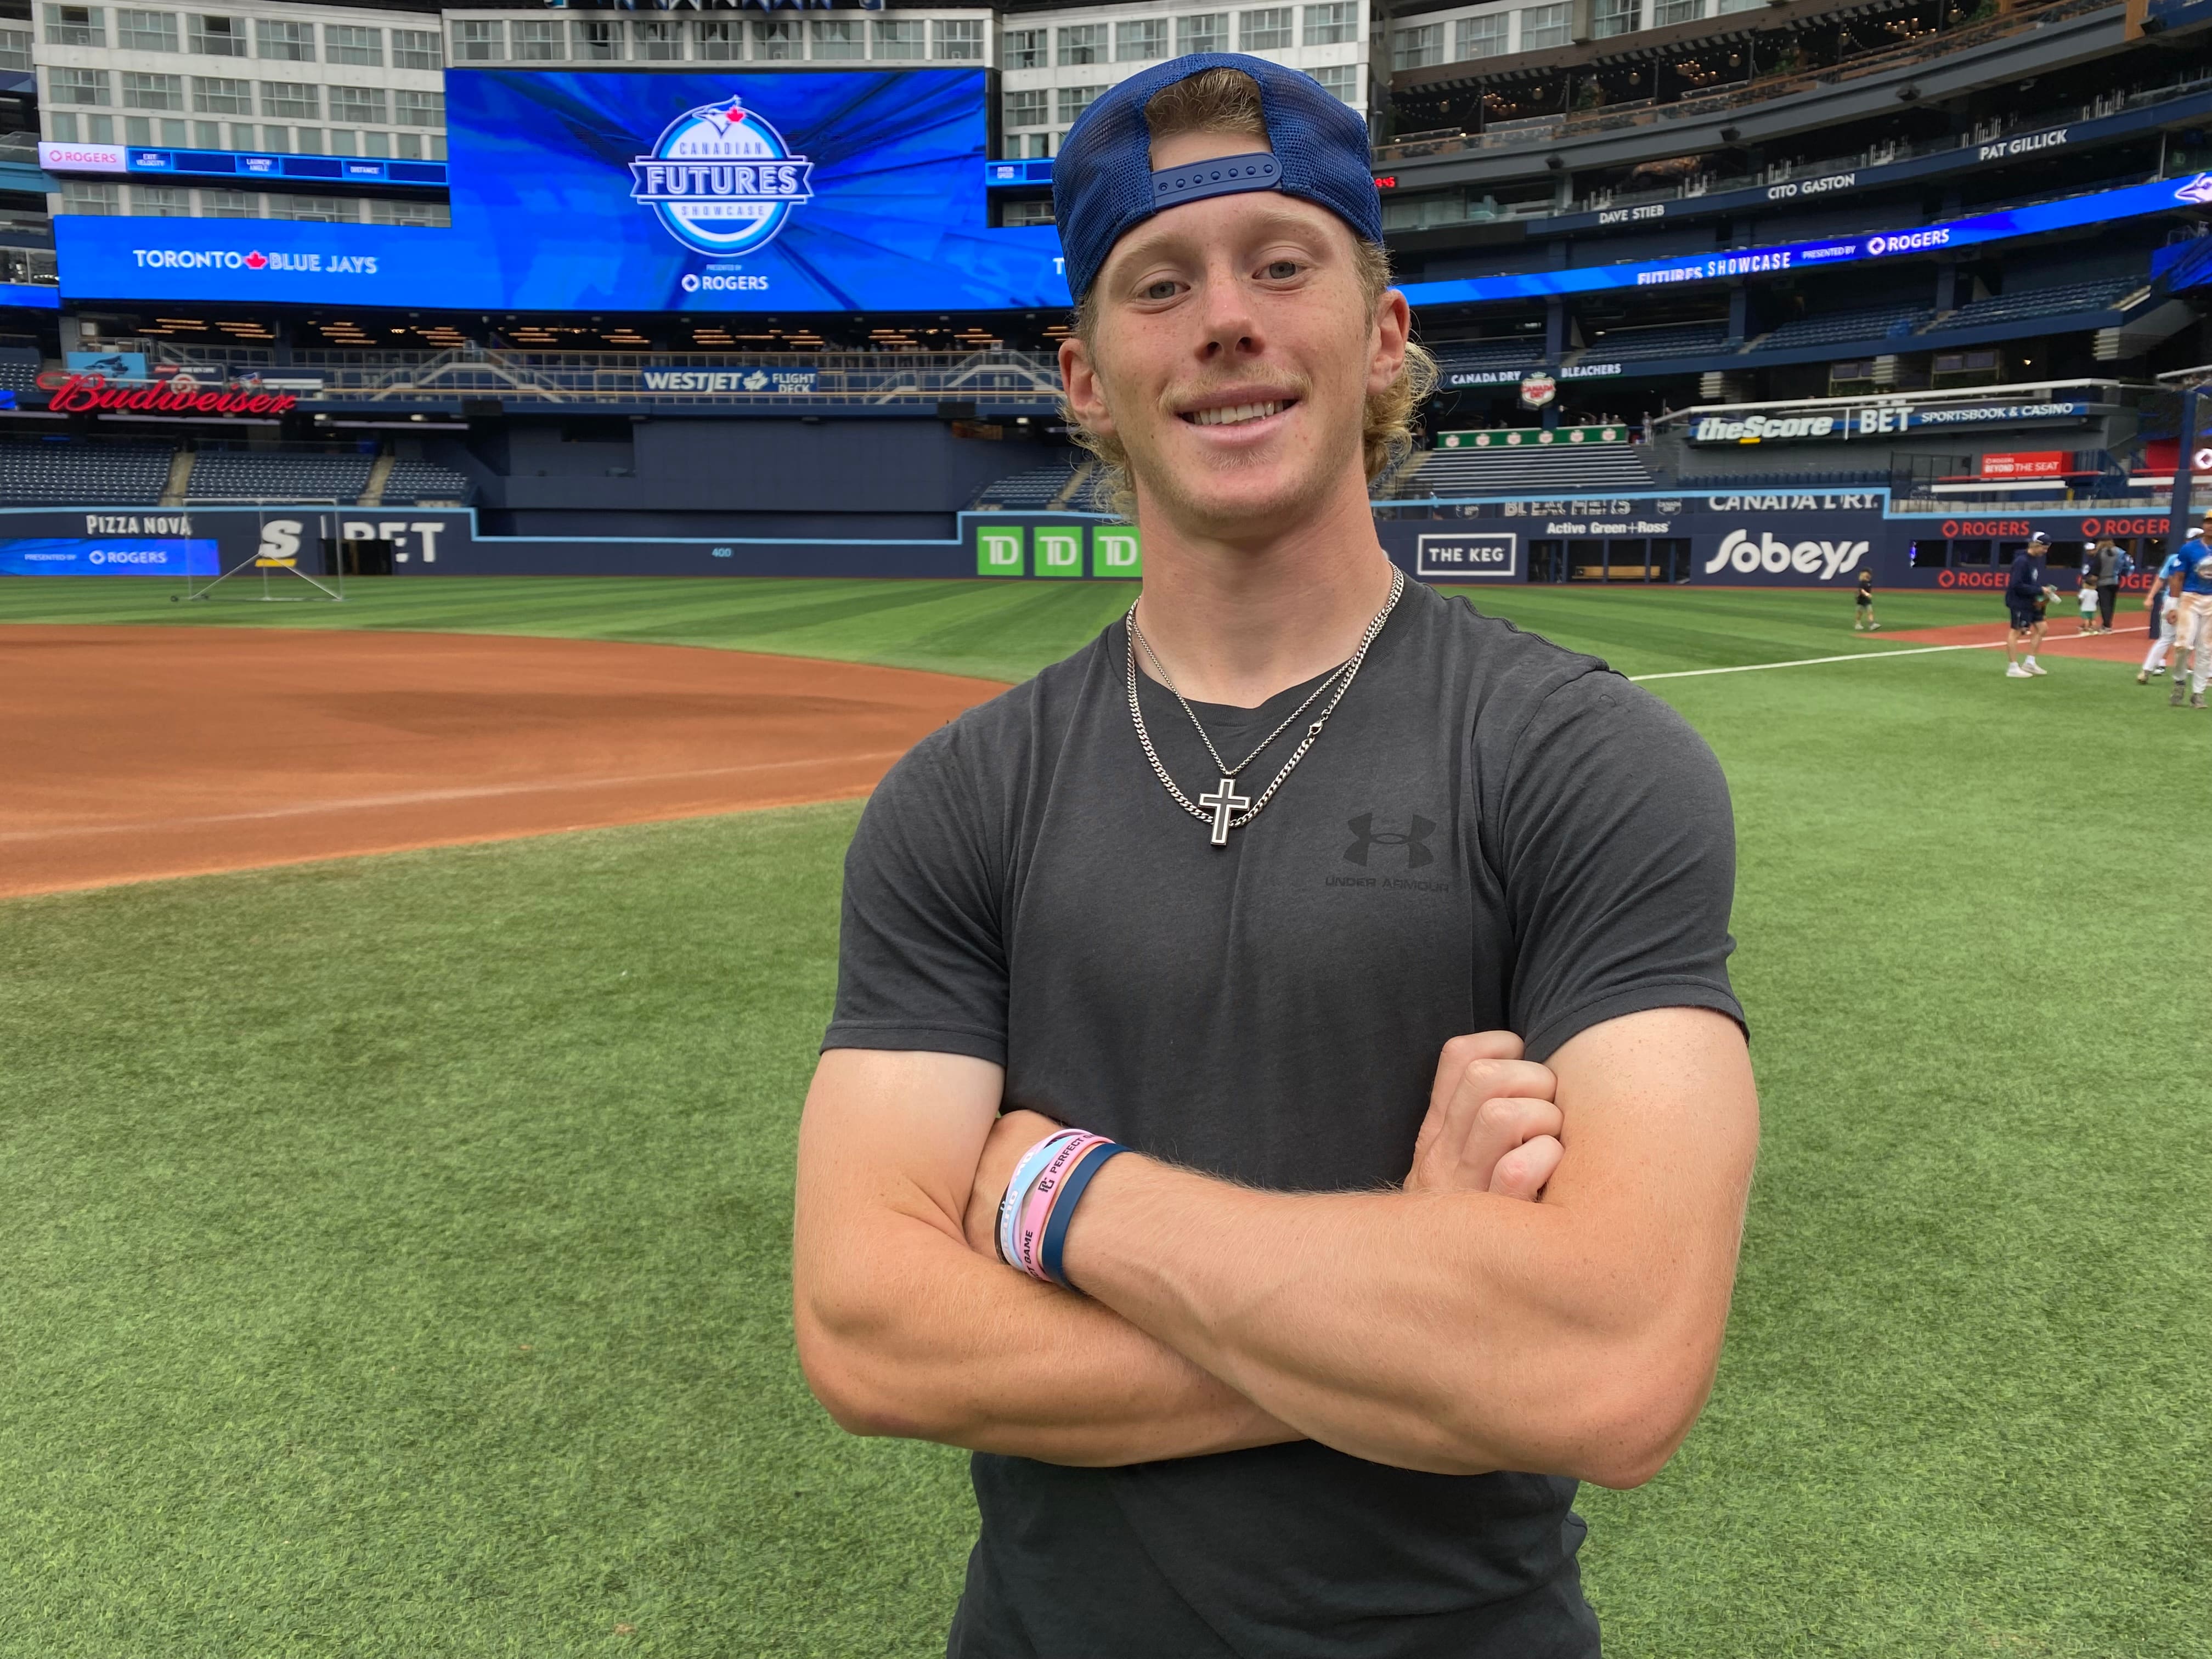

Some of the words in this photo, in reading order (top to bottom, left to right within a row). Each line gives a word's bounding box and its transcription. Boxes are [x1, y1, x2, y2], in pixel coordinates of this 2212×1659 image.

[680, 142, 763, 155] CANADIAN
[1979, 143, 2007, 161] PAT
[2010, 129, 2068, 154] GILLICK
[65, 152, 117, 163] ROGERS
[647, 166, 798, 194] FUTURES
[1768, 183, 1797, 200] CITO
[1802, 173, 1855, 194] GASTON
[681, 206, 765, 216] SHOWCASE
[1599, 210, 1629, 224] DAVE
[1632, 204, 1665, 219] STIEB
[132, 249, 242, 269] TORONTO
[269, 252, 321, 272] BLUE
[325, 255, 379, 274] JAYS
[1707, 251, 1791, 277] SHOWCASE
[1888, 228, 1950, 251] ROGERS
[702, 275, 769, 291] ROGERS
[643, 371, 743, 394] WESTJET
[771, 373, 816, 383] FLIGHT
[1451, 372, 1497, 385] CANADA
[1499, 370, 1522, 382] DRY
[1561, 363, 1622, 378] BLEACHERS
[36, 371, 297, 414] Budweiser
[778, 385, 811, 393] DECK
[1696, 415, 1834, 441] theScore
[1859, 407, 1915, 435] BET
[1921, 407, 2006, 423] SPORTSBOOK
[2008, 406, 2019, 417] &
[2022, 403, 2074, 418] CASINO
[2014, 462, 2034, 472] THE
[2035, 461, 2059, 471] SEAT
[86, 515, 141, 535] PIZZA
[144, 516, 192, 536] NOVA
[1547, 522, 1586, 534] Active
[1962, 521, 2029, 535] ROGERS
[2104, 518, 2170, 534] ROGER
[259, 520, 303, 558] S
[981, 535, 1019, 565] TD
[108, 551, 167, 564] ROGERS
[712, 548, 731, 557] 400
[1039, 536, 1077, 566] TD
[1098, 536, 1137, 566] TD
[1429, 548, 1464, 562] THE
[1469, 548, 1504, 562] KEG
[1705, 528, 1870, 580] Sobeys
[1959, 572, 2011, 588] ROGE
[1325, 877, 1376, 887] UNDER
[1381, 878, 1449, 894] ARMOUR
[1049, 1137, 1085, 1173] PERFECT
[1024, 1230, 1033, 1264] GAME
